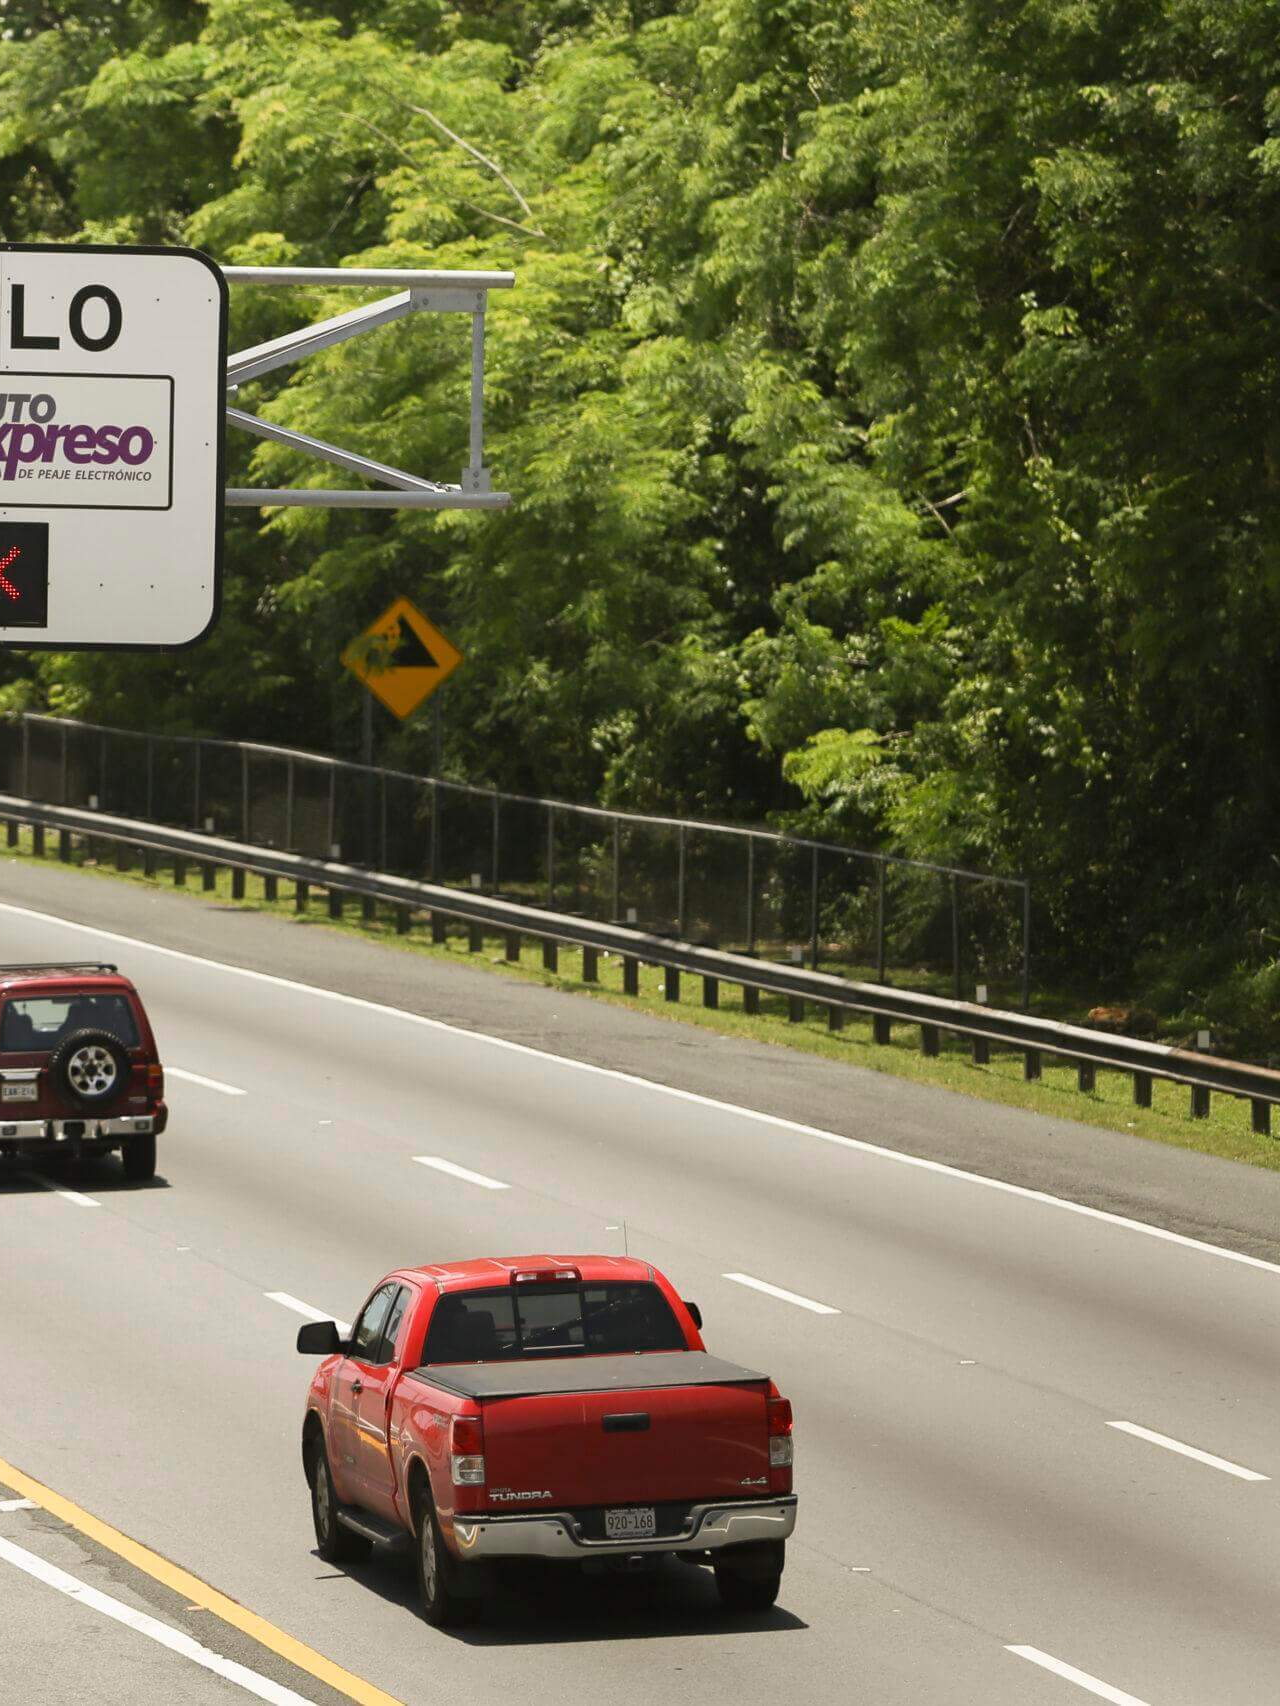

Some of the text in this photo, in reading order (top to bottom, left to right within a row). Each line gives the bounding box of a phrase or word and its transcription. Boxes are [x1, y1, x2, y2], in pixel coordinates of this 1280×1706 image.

[18, 468, 34, 479] DE
[37, 469, 71, 480] PEAJE
[74, 469, 152, 482] ELECTRÓNICO
[489, 1490, 553, 1502] TUNDRA
[607, 1514, 653, 1530] 920-168
